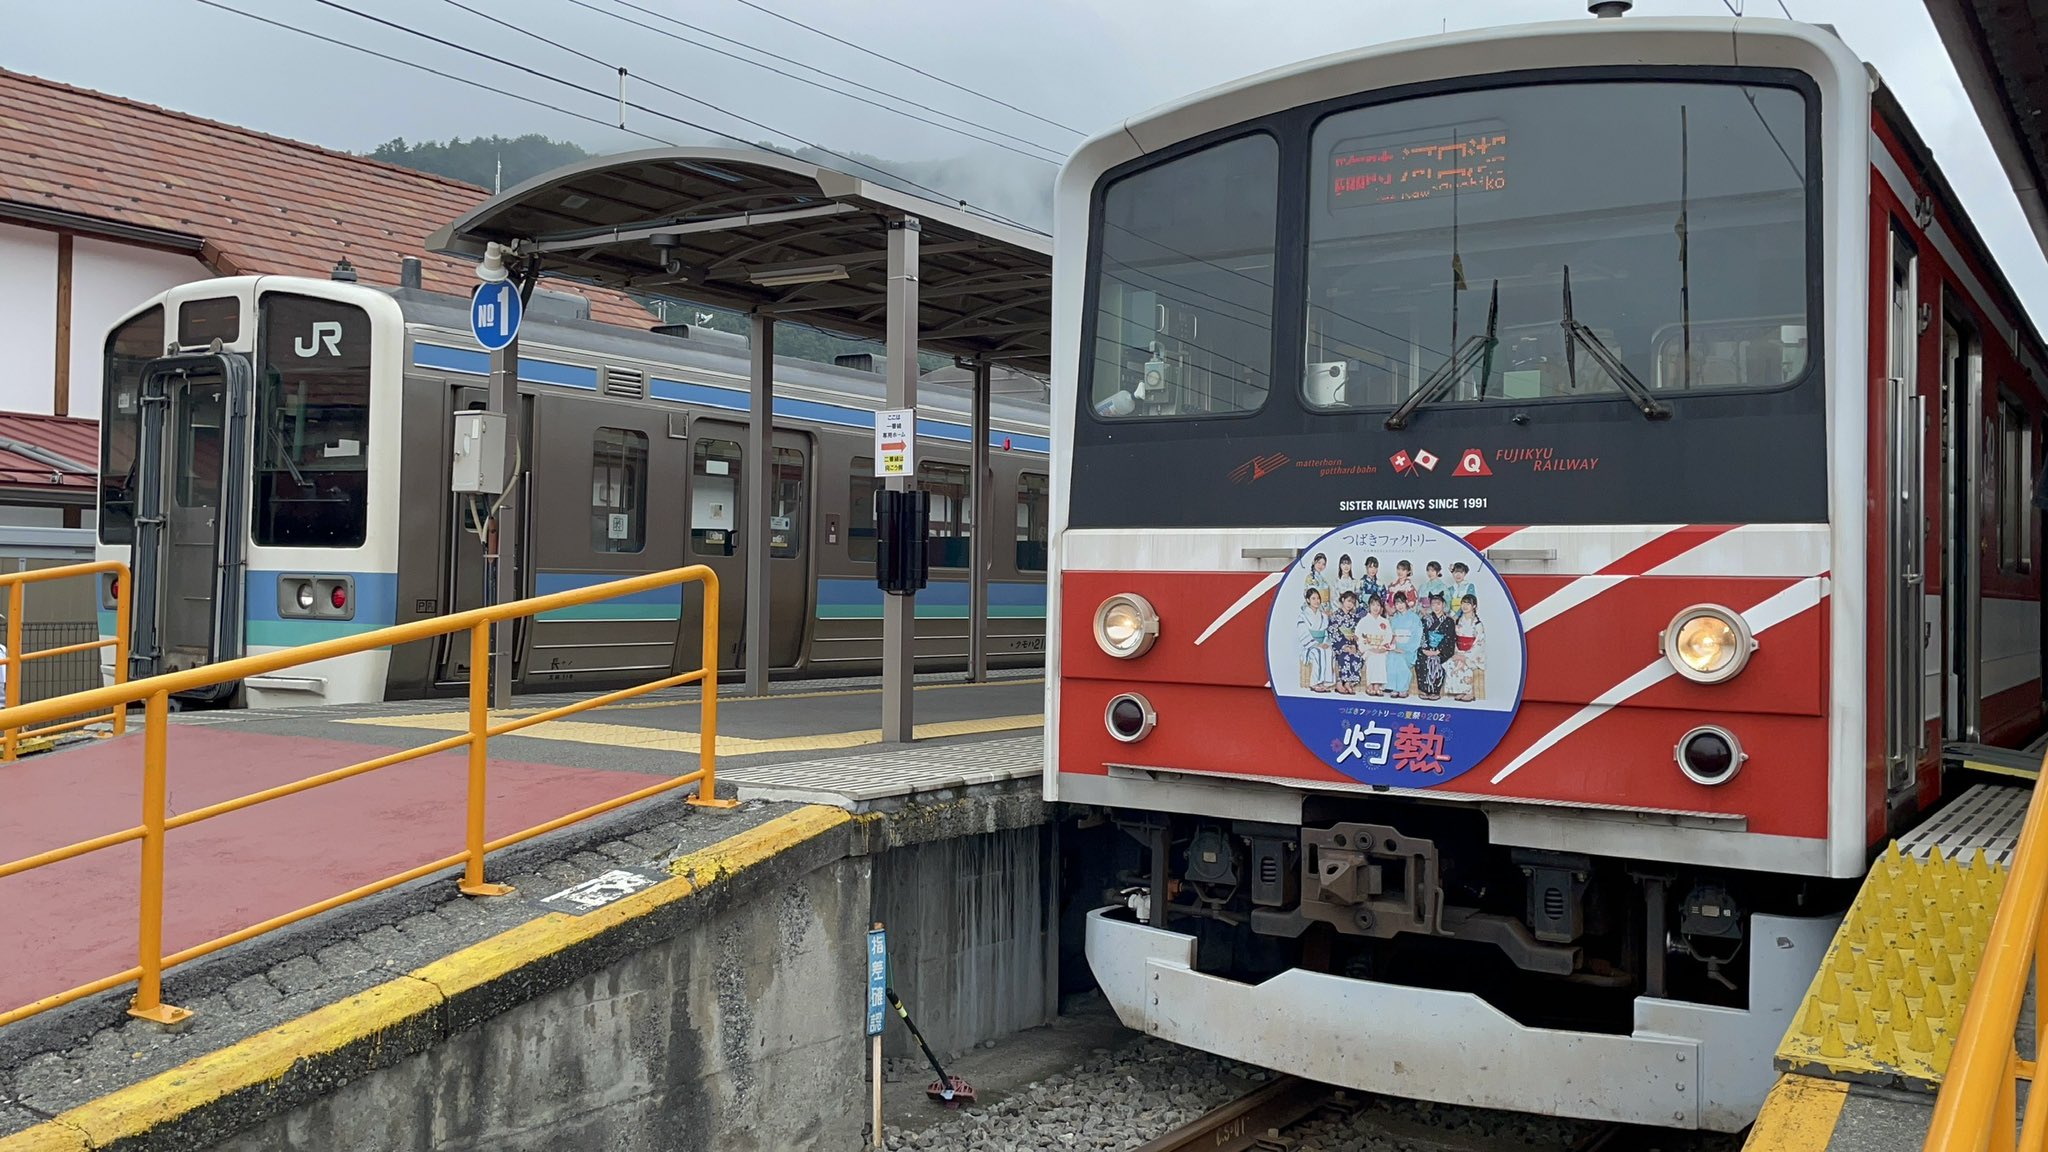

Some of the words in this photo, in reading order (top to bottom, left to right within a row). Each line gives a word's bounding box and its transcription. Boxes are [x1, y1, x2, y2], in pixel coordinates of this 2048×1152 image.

[497, 286, 509, 336] 1
[294, 321, 343, 358] JR
[1295, 458, 1342, 468] matterhorn
[1463, 453, 1481, 473] Q
[1495, 447, 1554, 464] FUJIKYU
[1319, 465, 1356, 478] gotthard
[1356, 465, 1377, 474] bahn
[1533, 457, 1599, 472] RAILWAY
[1339, 500, 1374, 512] SISTER
[1376, 499, 1425, 511] RAILWAYS
[1428, 498, 1459, 510] SINCE
[1462, 497, 1488, 509] 1991
[1342, 533, 1438, 547] つばきファクトリー
[1338, 707, 1452, 721] つばきファクトリーの夏祭り2022
[1336, 720, 1452, 773] 灼熱
[869, 935, 884, 1033] 指差確認
